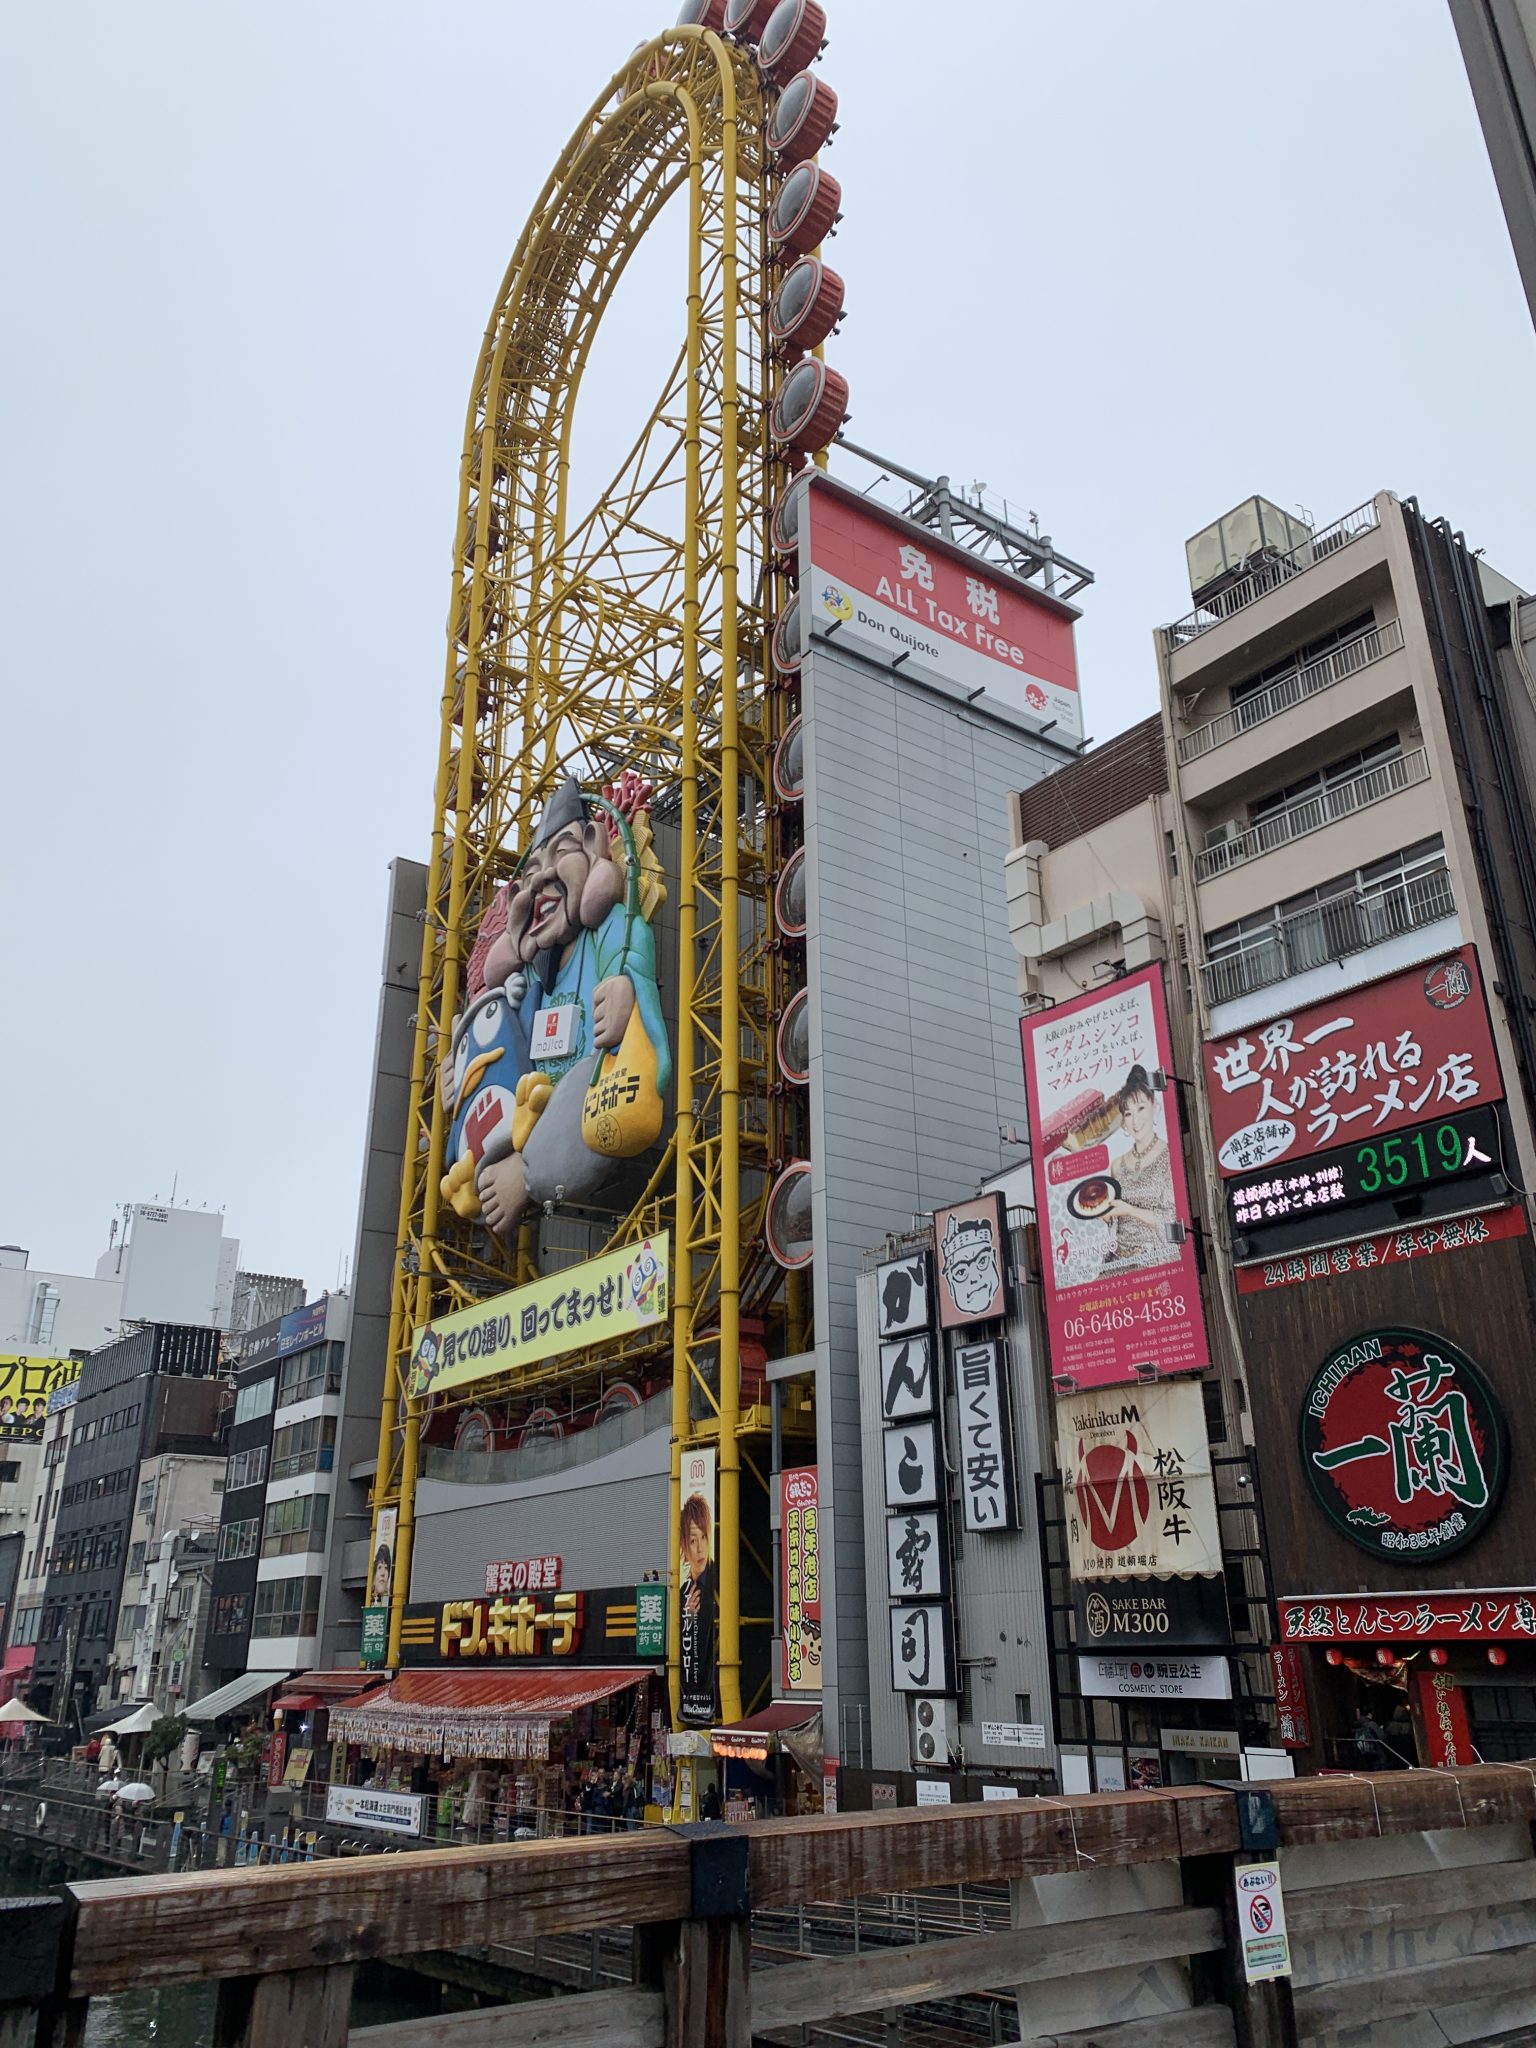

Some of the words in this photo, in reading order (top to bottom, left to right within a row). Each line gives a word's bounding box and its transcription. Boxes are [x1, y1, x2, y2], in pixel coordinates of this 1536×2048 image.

[857, 610, 885, 633] Don
[889, 626, 939, 658] Quijote
[875, 576, 918, 614] ALL
[925, 598, 968, 639] Tax
[974, 622, 1024, 665] Free
[1046, 1014, 1139, 1059] マダムシンコ
[1212, 1016, 1354, 1093] 世界一
[1048, 1047, 1144, 1091] マダムブリュレ
[1256, 1030, 1422, 1122] 人が訪れる
[1307, 1053, 1479, 1147] ラーメン店
[1221, 1123, 1291, 1160] 一蘭全店舗中
[1238, 1145, 1279, 1168] 世界一
[1064, 1295, 1186, 1340] 06-6468-4538
[1309, 1338, 1382, 1419] ICHIRAN
[961, 1348, 999, 1523] 旨くて安い
[1313, 1354, 1489, 1508] 一蘭
[1153, 1447, 1192, 1546] 松阪牛
[1382, 1512, 1466, 1550] 昭和35年創業
[485, 1557, 559, 1594] 驚安の殿堂
[802, 1506, 818, 1602] 百年老店
[364, 1614, 385, 1636] 薬
[640, 1594, 662, 1623] 薬
[1112, 1598, 1139, 1610] SAKE
[1141, 1598, 1167, 1609] BAR
[1113, 1612, 1169, 1633] M300
[1285, 1596, 1536, 1637] 天然とんこつラーメン専
[1118, 1683, 1156, 1694] COSMETIC
[1160, 1684, 1183, 1694] STORE
